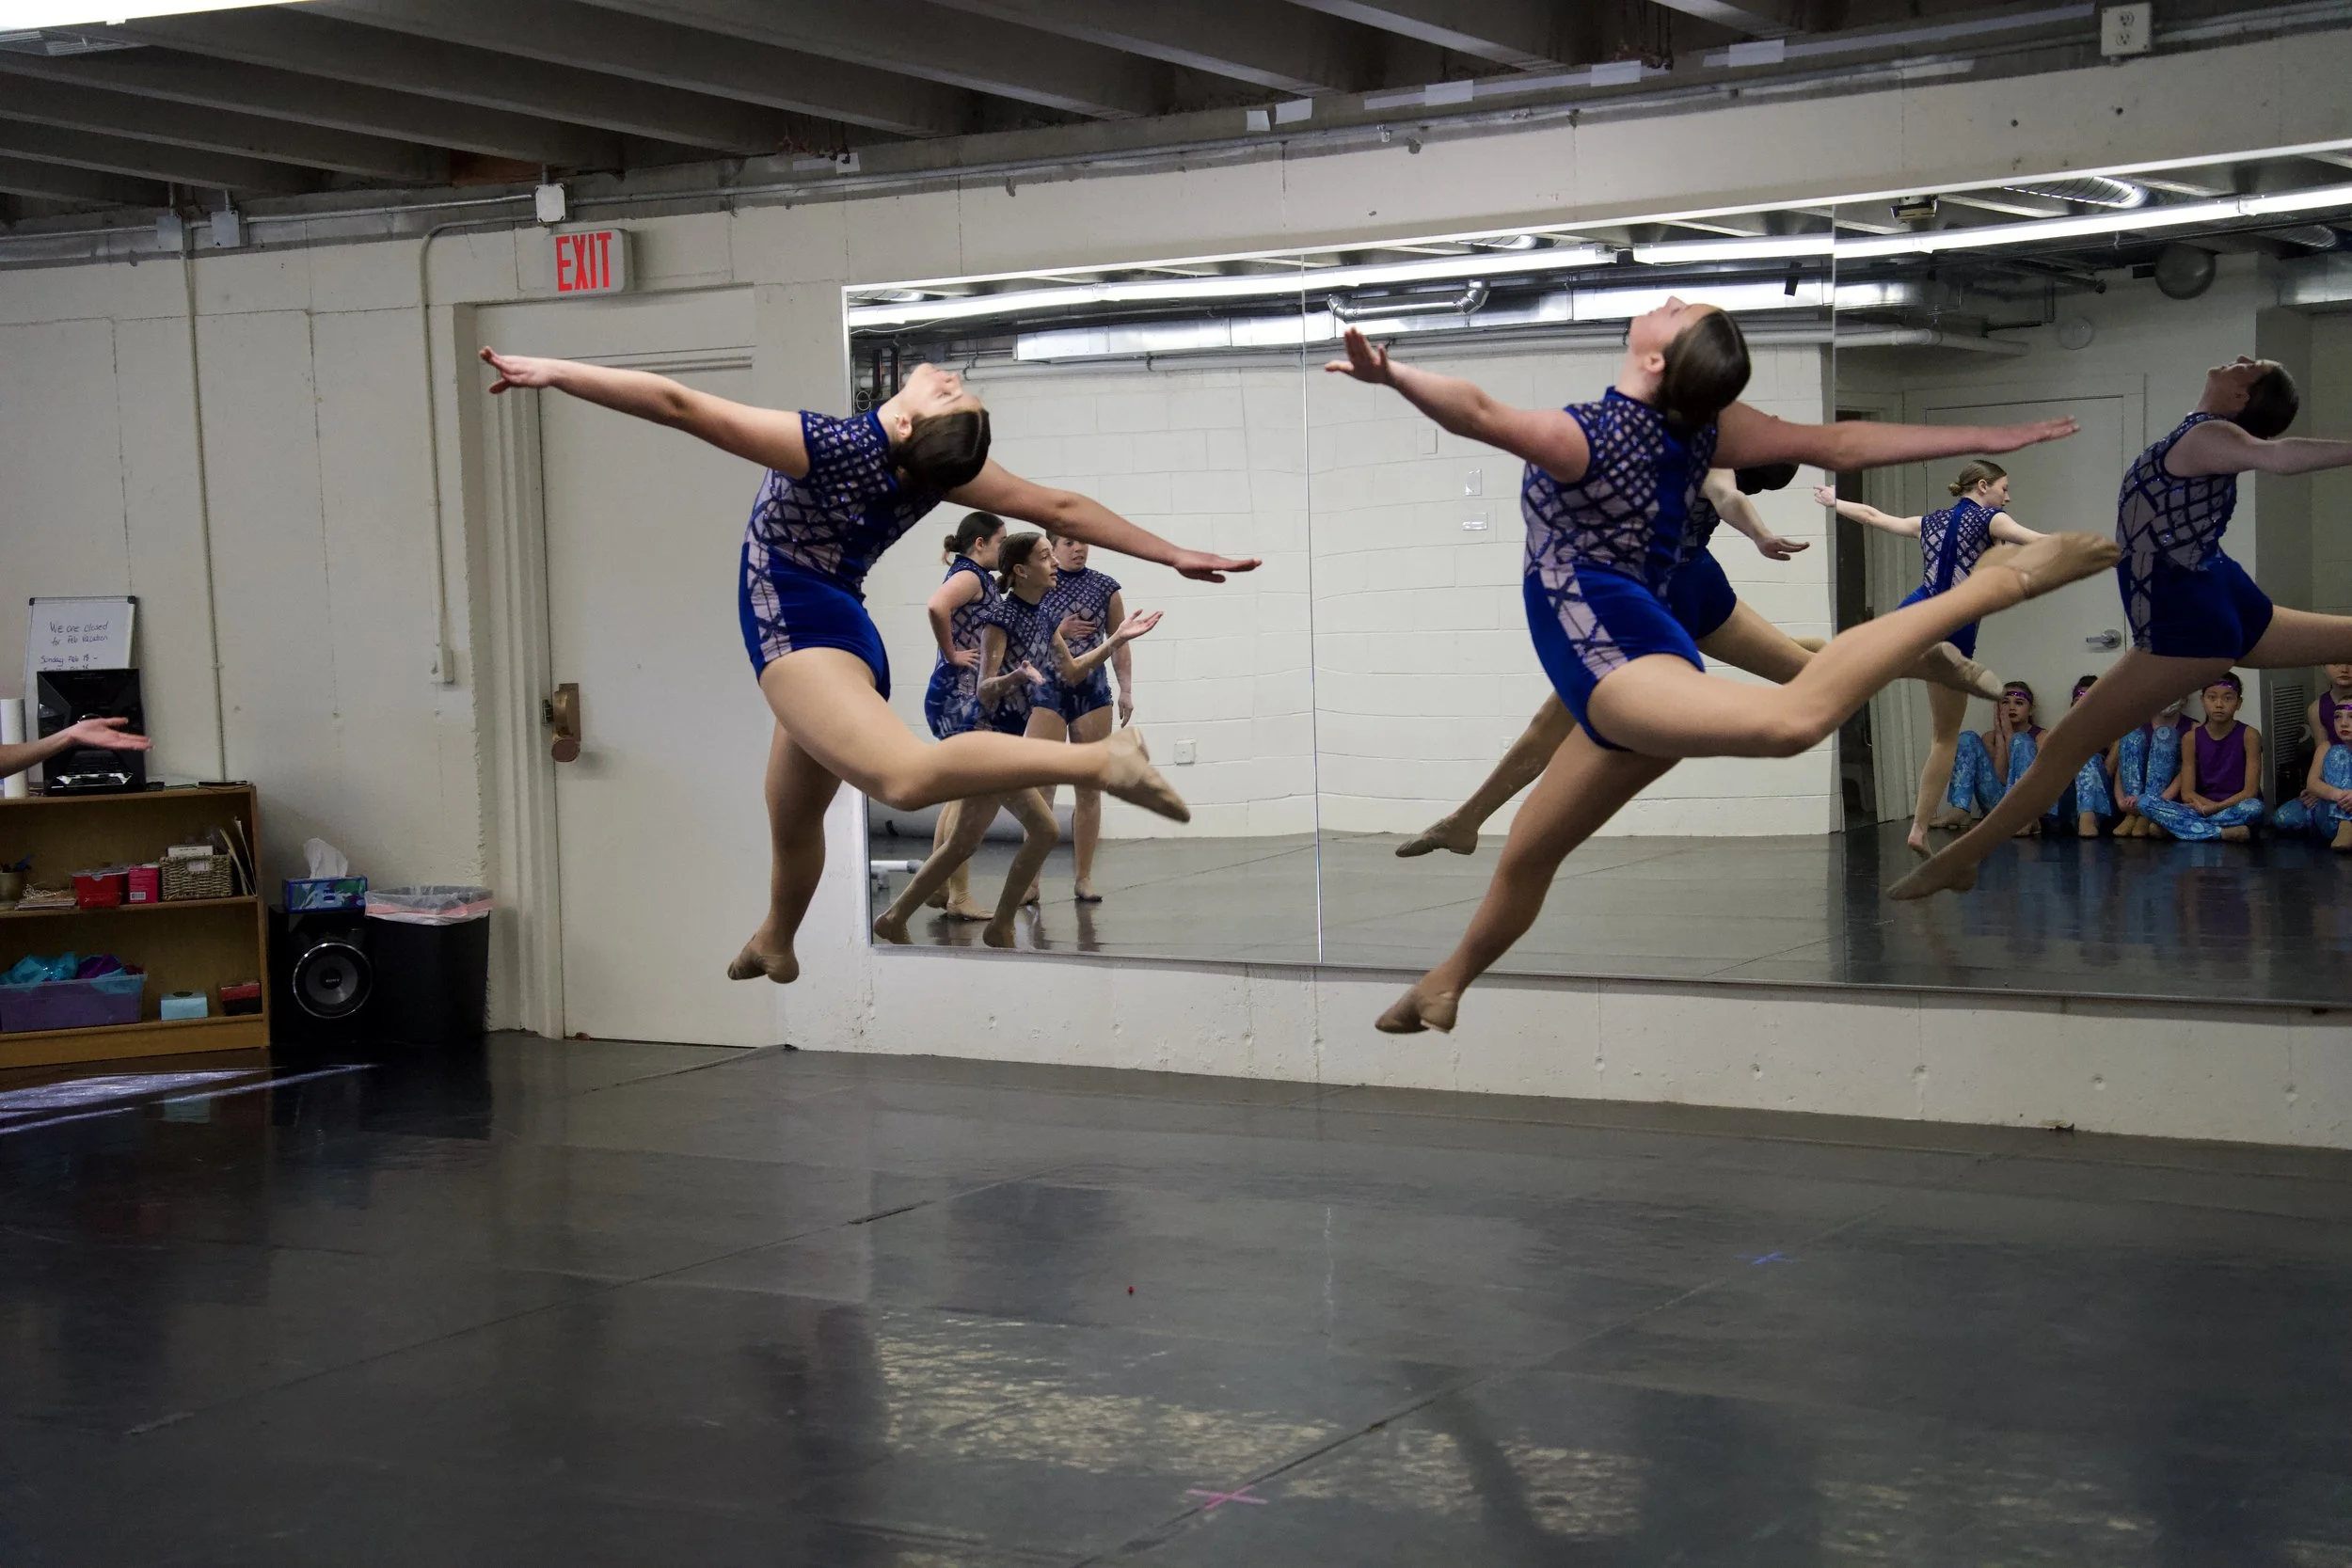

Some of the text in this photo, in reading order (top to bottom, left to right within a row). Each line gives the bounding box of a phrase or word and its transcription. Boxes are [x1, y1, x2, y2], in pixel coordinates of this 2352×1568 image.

[556, 232, 612, 292] EXIT
[51, 636, 61, 646] for
[40, 655, 64, 667] Sunday
